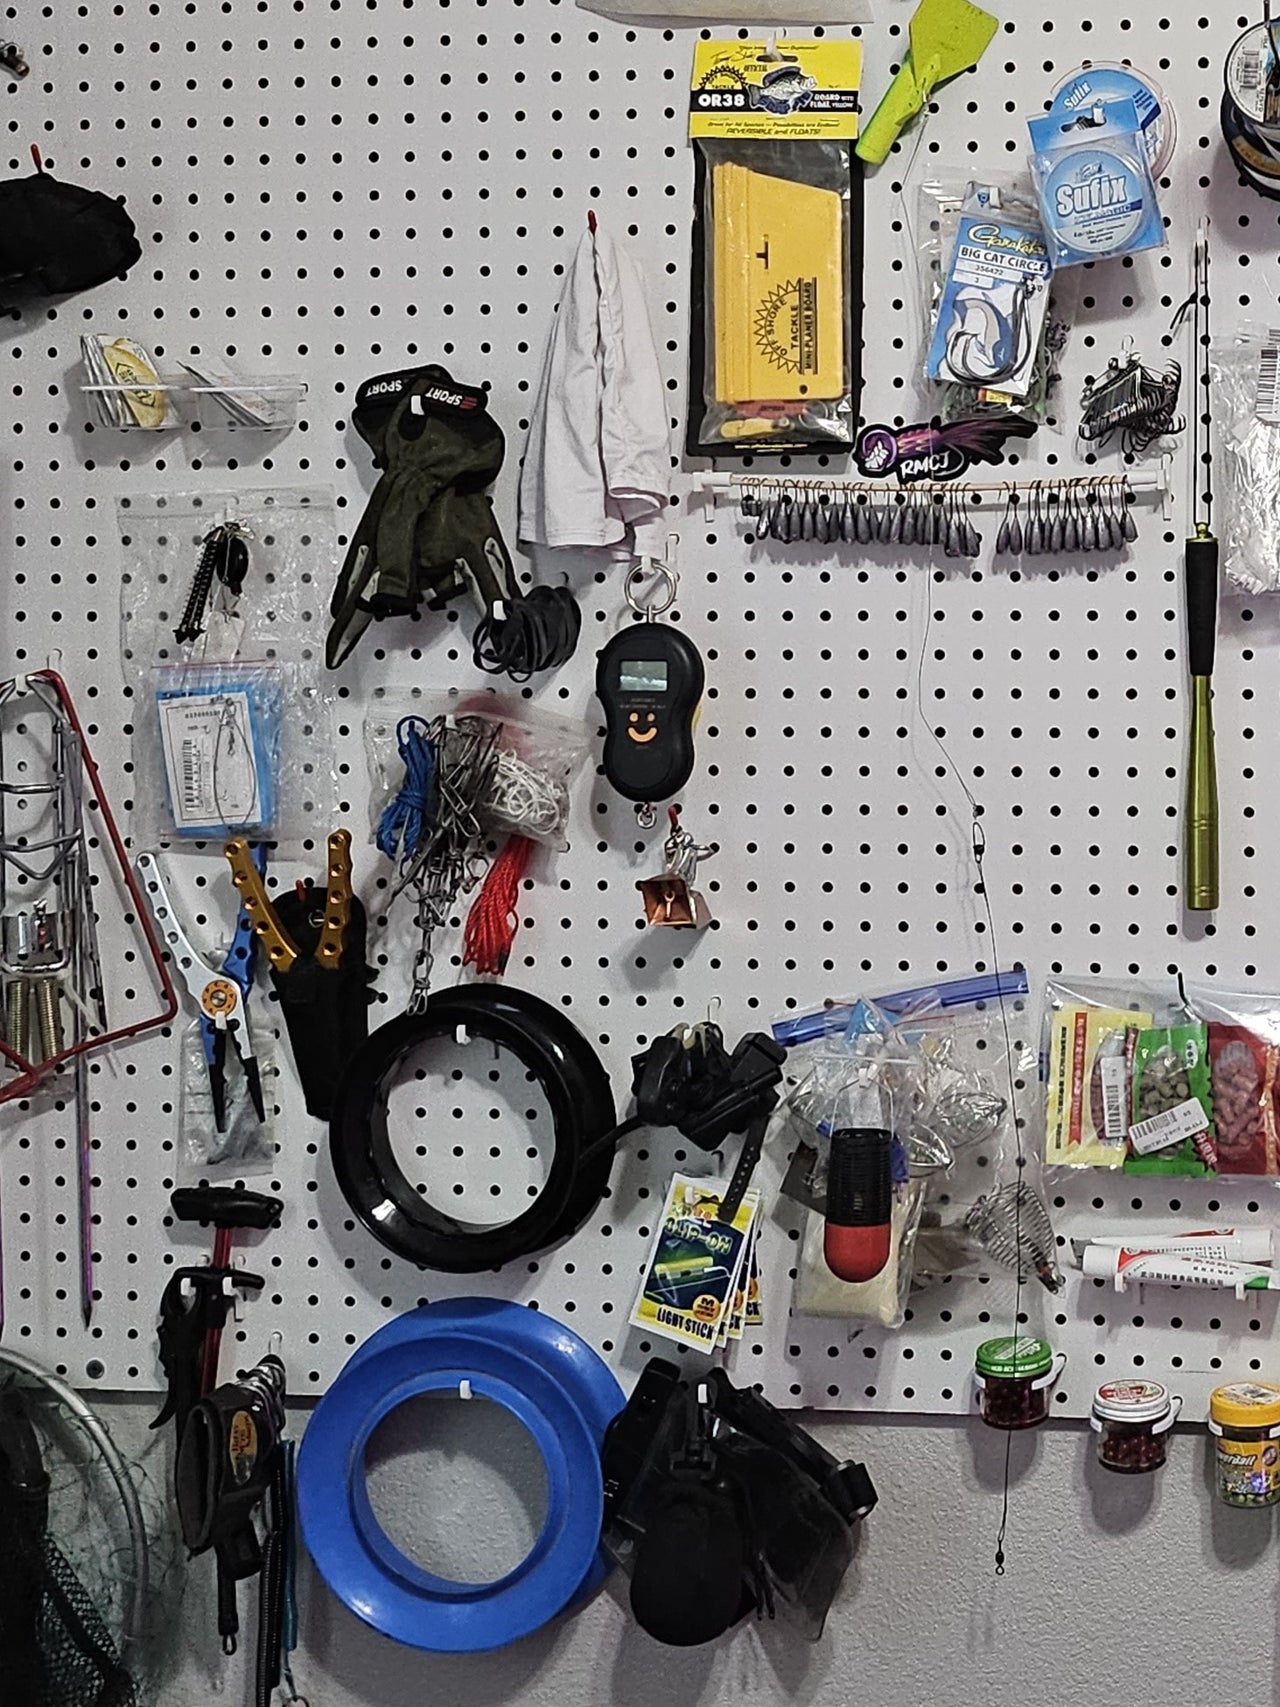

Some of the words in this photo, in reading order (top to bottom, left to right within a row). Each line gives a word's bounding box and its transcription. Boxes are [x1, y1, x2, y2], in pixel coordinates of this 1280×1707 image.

[698, 94, 745, 107] OR38
[1063, 80, 1092, 110] Sufix
[1057, 175, 1127, 216] Sufix
[961, 247, 980, 258] BIG
[984, 252, 1005, 264] CAT
[767, 299, 787, 336] SHORE
[790, 304, 798, 349] TACKLE
[770, 340, 787, 356] OFF
[365, 380, 403, 398] SPORT
[425, 387, 462, 406] SPORT
[657, 1307, 685, 1328] LIGHT
[685, 1319, 715, 1341] STICK
